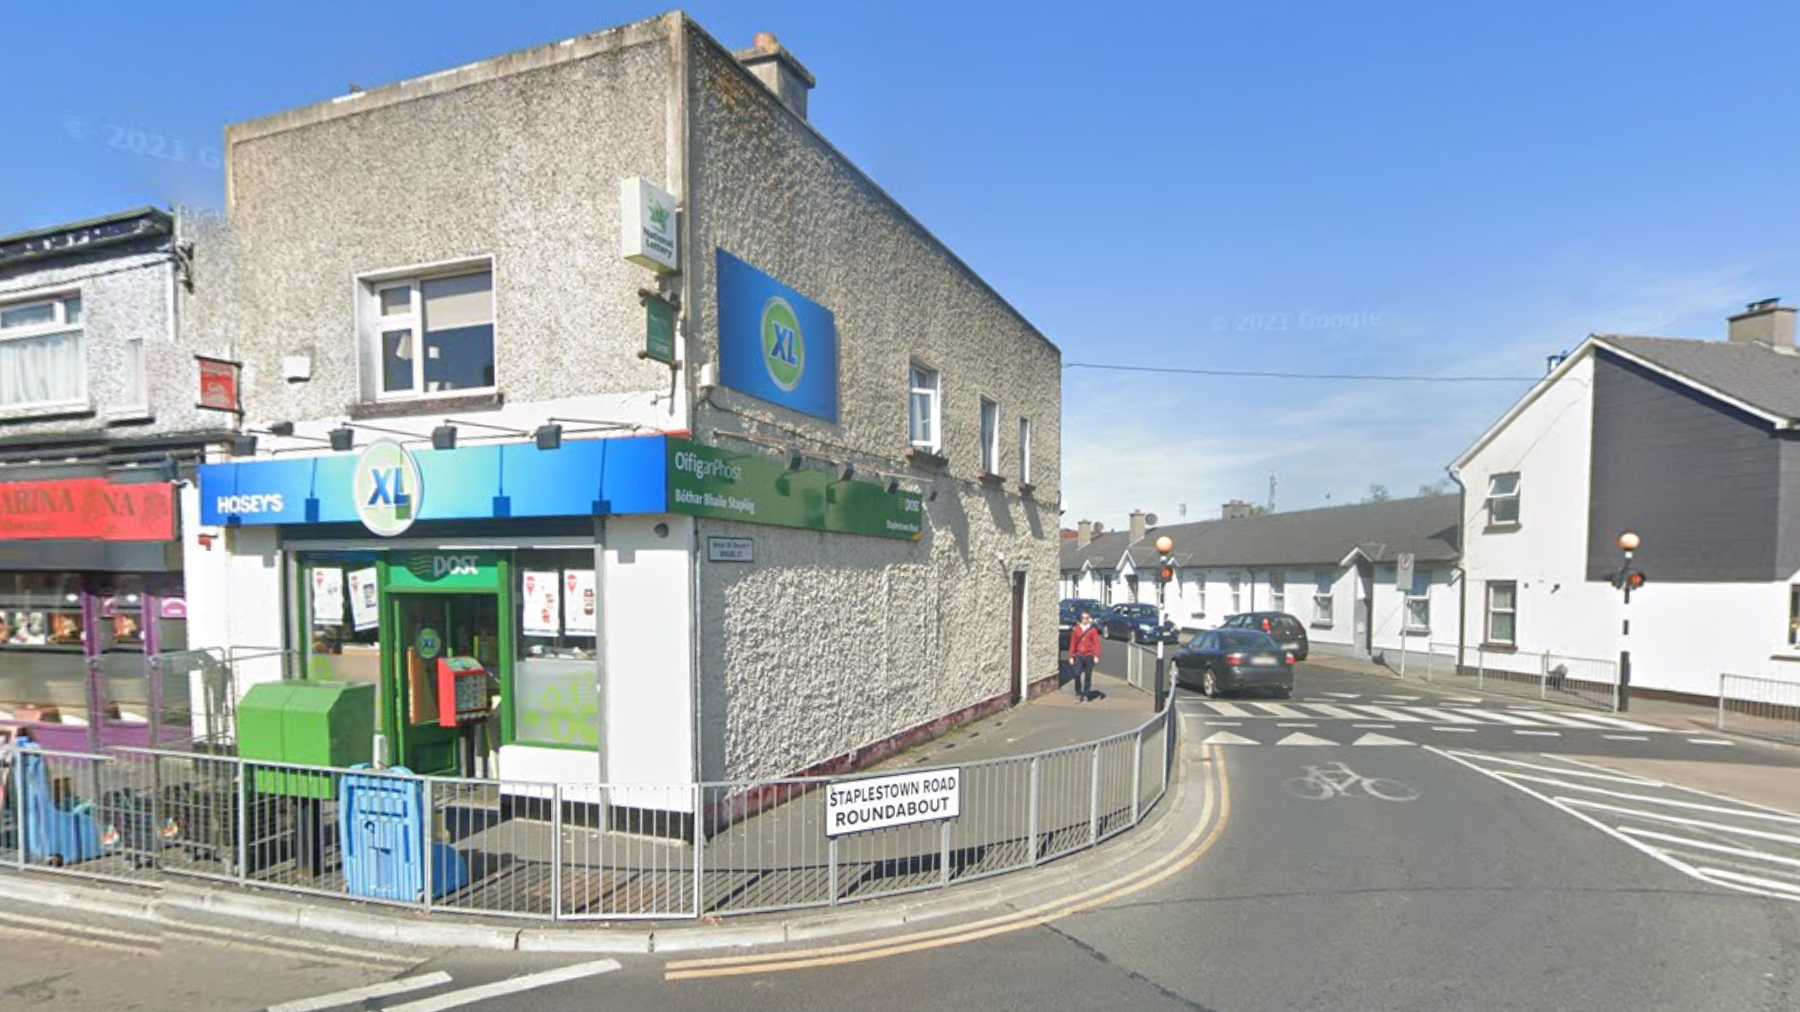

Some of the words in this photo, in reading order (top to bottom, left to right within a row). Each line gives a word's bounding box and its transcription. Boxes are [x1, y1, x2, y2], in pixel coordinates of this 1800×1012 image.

[645, 237, 672, 259] Lottery
[770, 320, 798, 367] XL
[368, 467, 410, 505] XL
[217, 493, 284, 514] HOSEY'S
[421, 638, 436, 649] XL
[830, 781, 920, 807] STAPLESTOWN
[923, 776, 956, 794] ROAD
[835, 797, 950, 827] ROUNDABOUT
